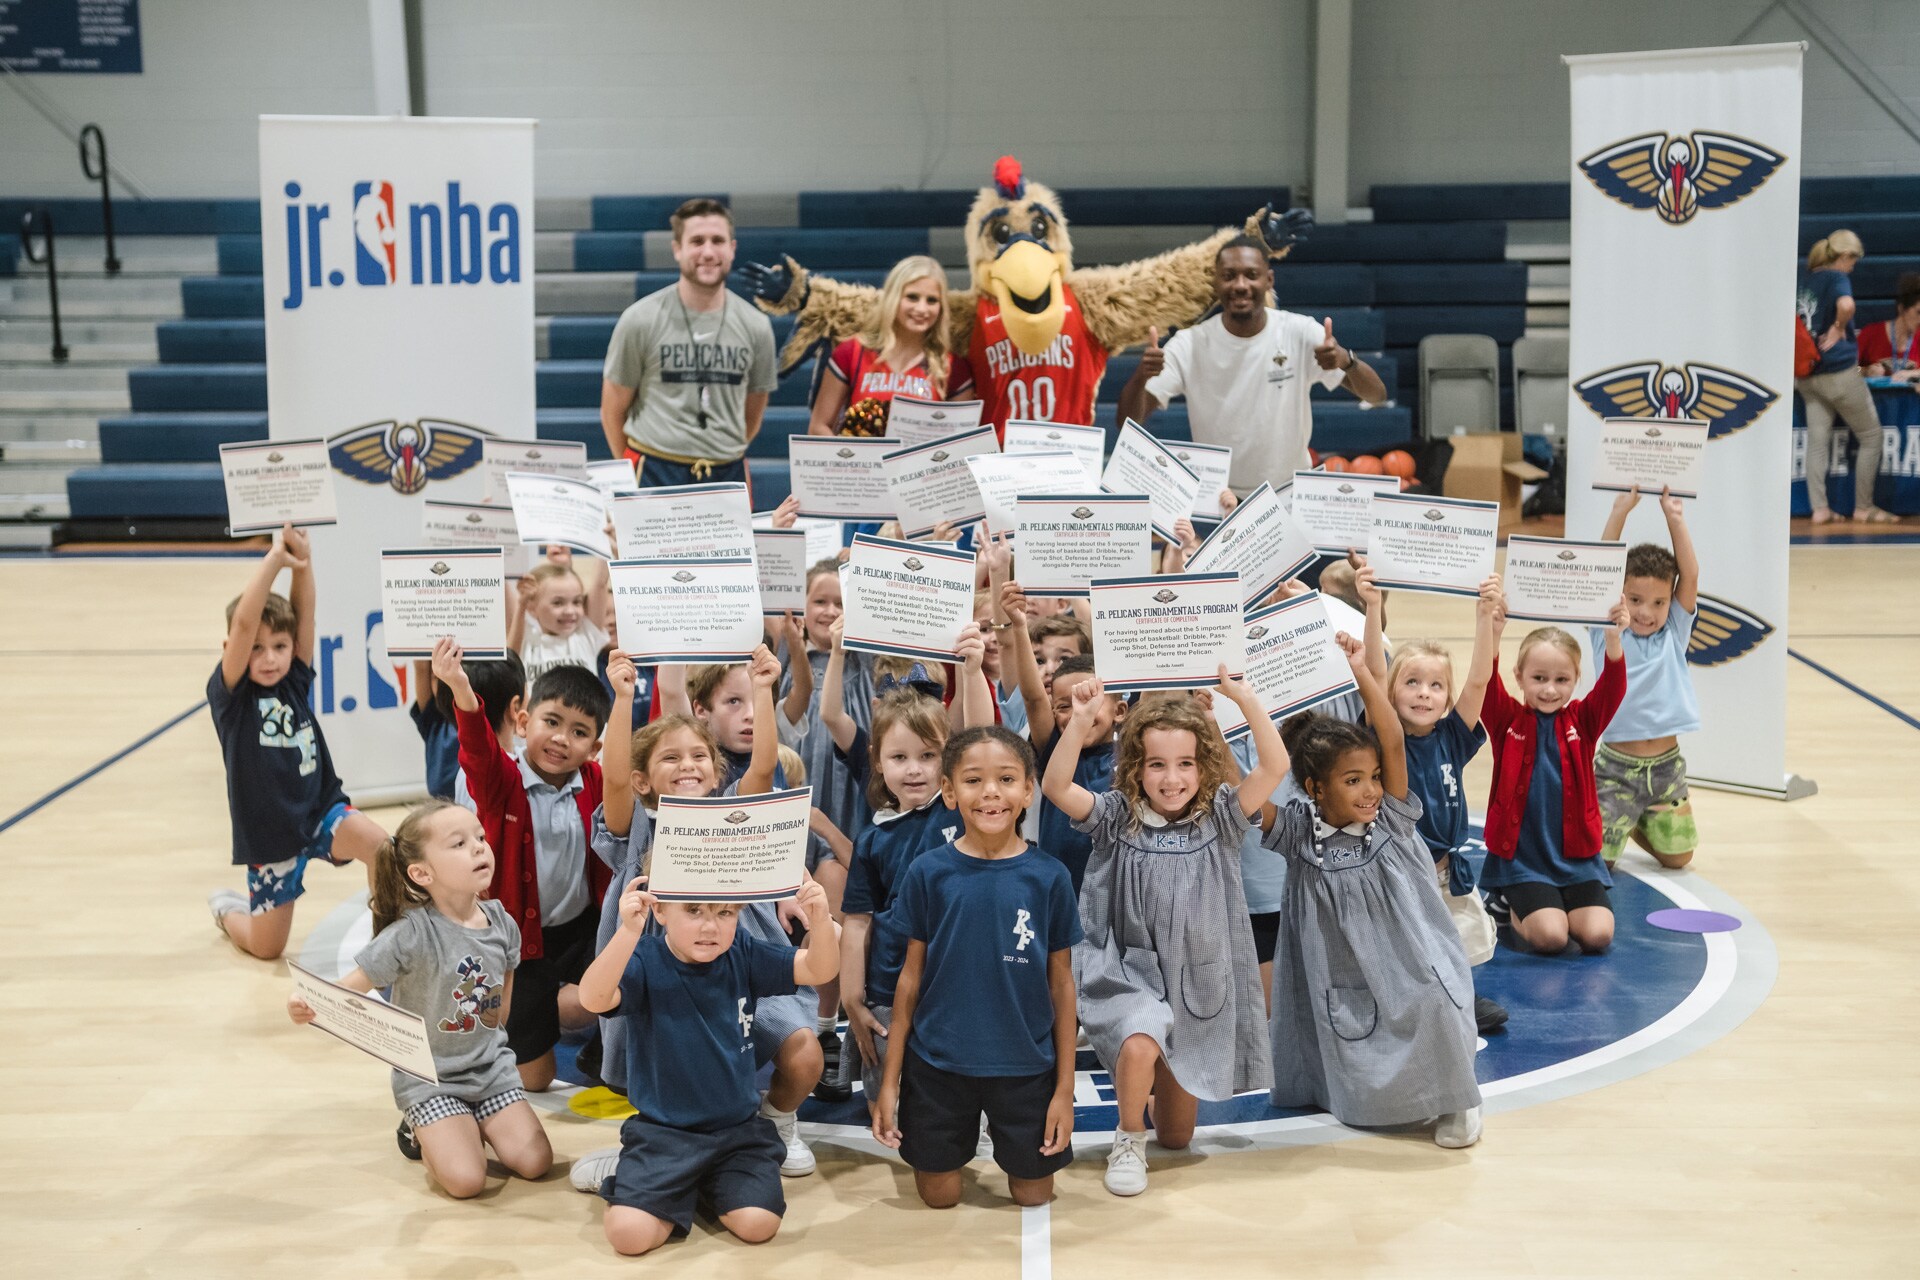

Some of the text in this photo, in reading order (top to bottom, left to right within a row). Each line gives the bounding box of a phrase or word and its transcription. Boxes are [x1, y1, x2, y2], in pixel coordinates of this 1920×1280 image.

[283, 181, 521, 309] jr. nba
[660, 343, 749, 371] PELICANS
[861, 372, 933, 400] PELICANS
[1007, 376, 1056, 421] 00
[900, 470, 925, 483] PELICANS
[926, 460, 968, 477] FUNDAMENTAL
[1019, 523, 1146, 531] JR. PELICANS FUNDAMENTALS PROGRAM
[1384, 520, 1412, 529] PELICANS
[1414, 522, 1462, 534] FUNDAMENTALS
[1463, 528, 1493, 538] PROGRAM
[1519, 560, 1547, 568] PELICANS
[1548, 562, 1591, 572] FUNDAMENTALS
[1594, 564, 1622, 573] PROGRAM
[394, 579, 420, 588] PELICANS
[422, 579, 469, 588] FUNDAMENTALS
[471, 578, 500, 587] PROGRAM
[853, 566, 971, 593] JR. PELICANS FUNDAMENTALS PROGRAM
[618, 585, 755, 595] JR. PELICANS FUNDAMENTALS PROGRAM
[1096, 603, 1238, 619] JR. PELICANS FUNDAMENTALS PROGRAM
[1110, 636, 1138, 644] concepts
[1184, 633, 1209, 641] Dribble,
[1117, 628, 1138, 637] having
[1202, 624, 1231, 633] important
[1245, 619, 1327, 656] UNDAMENTALS PROGRAM
[1113, 644, 1130, 652] Jump
[1132, 643, 1148, 651] Shot,
[1125, 651, 1155, 659] alongside
[1246, 663, 1265, 673] earned
[1267, 656, 1282, 665] about
[1299, 639, 1327, 653] important
[660, 819, 805, 837] JR. PELICANS FUNDAMENTALS PROGRAM
[768, 840, 796, 850] important
[755, 856, 787, 864] Teamwork-
